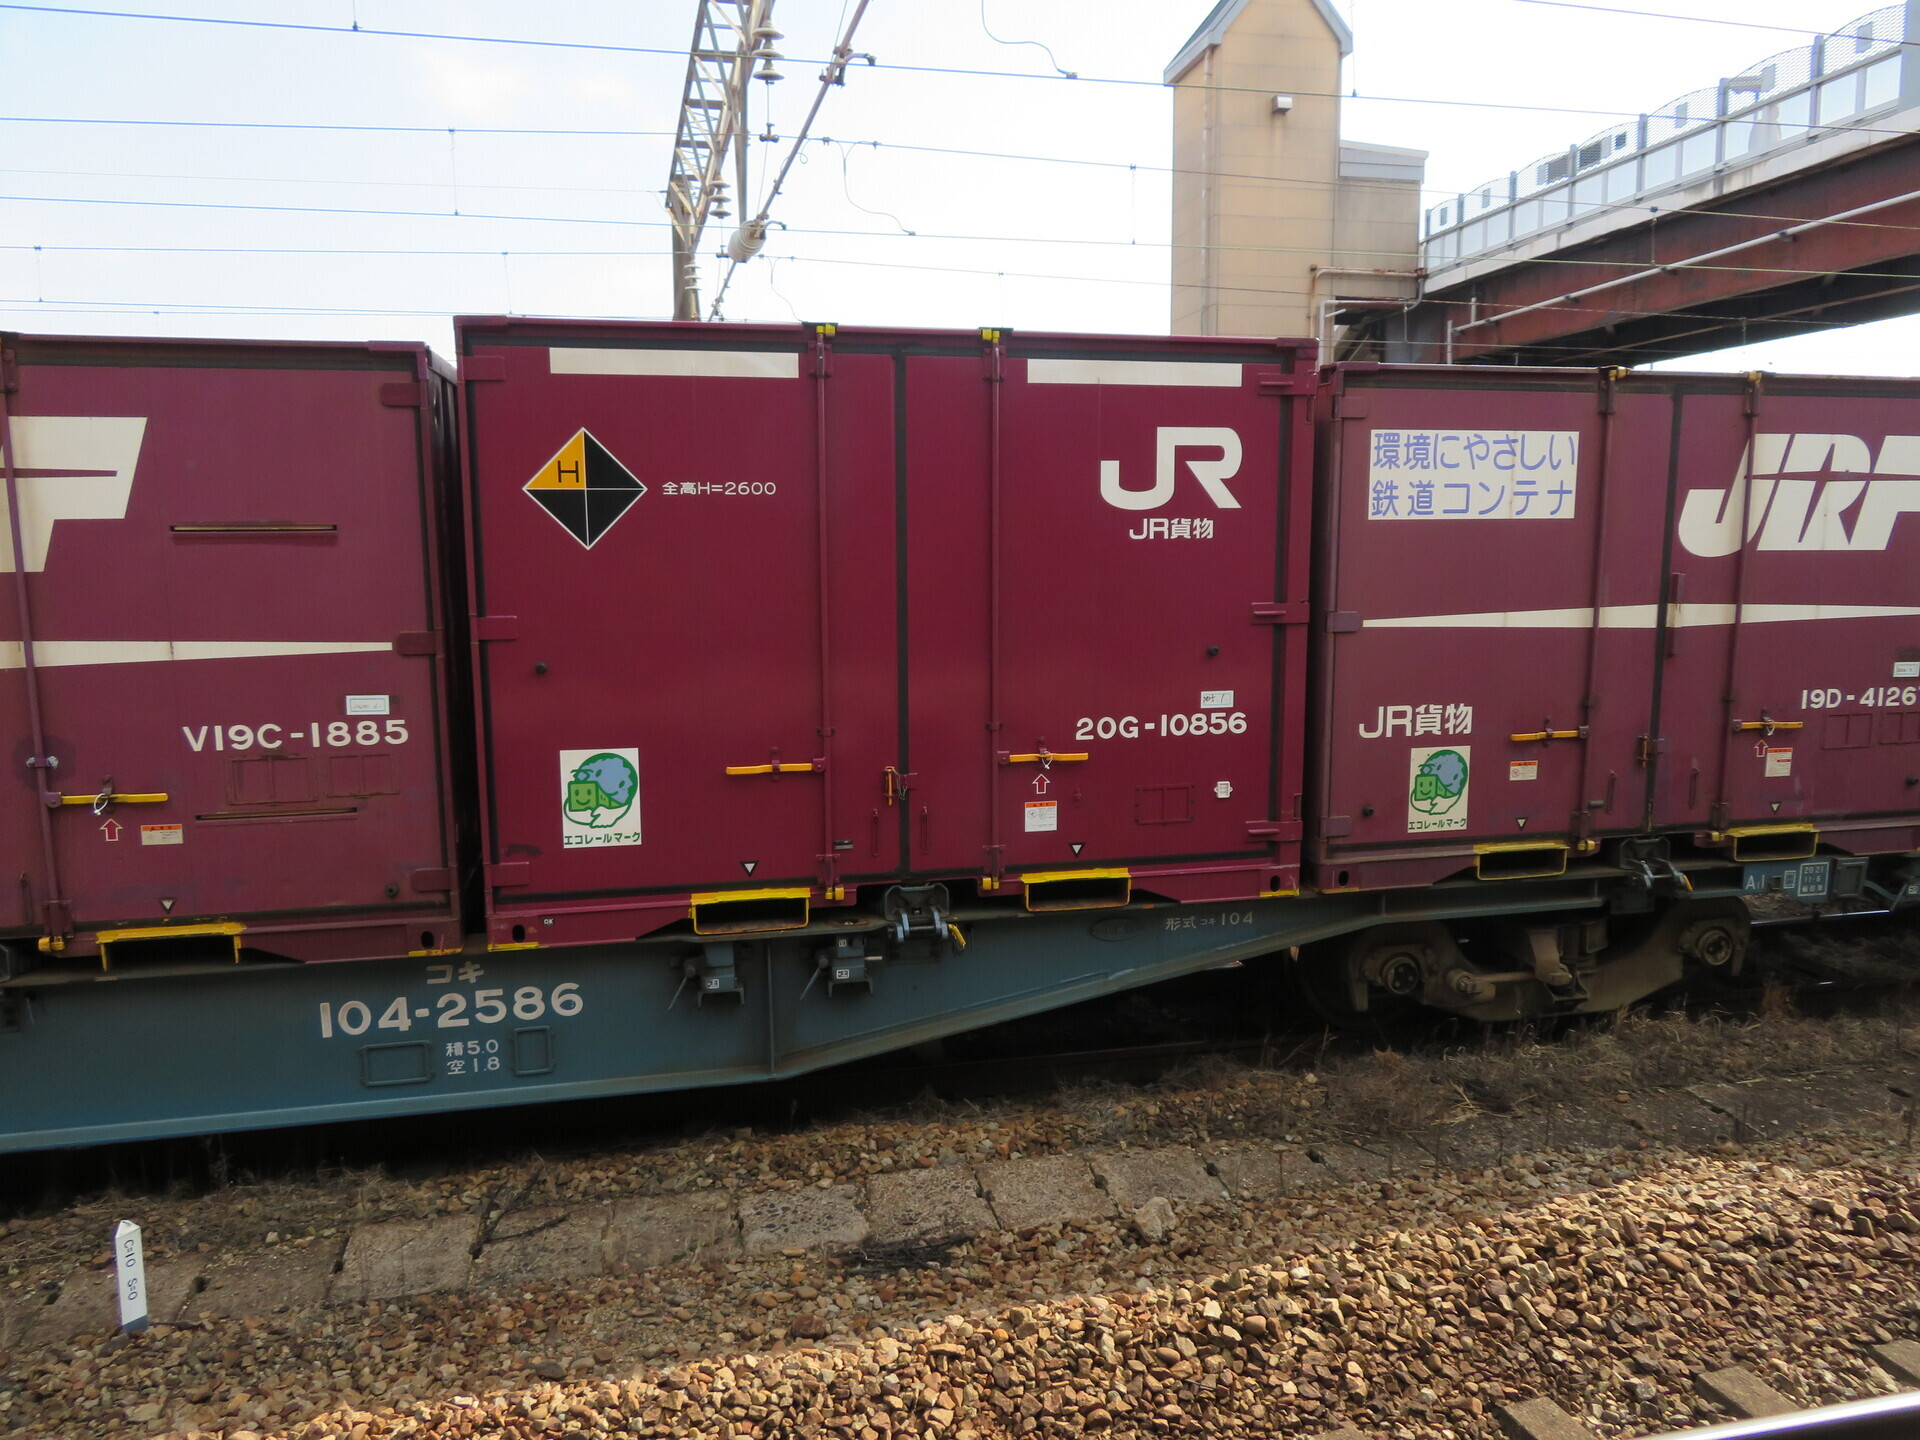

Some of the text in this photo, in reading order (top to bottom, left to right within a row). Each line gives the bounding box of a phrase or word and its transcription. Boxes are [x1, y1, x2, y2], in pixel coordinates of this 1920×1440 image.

[1372, 432, 1576, 471] 環境にやさしい
[557, 460, 580, 483] H
[1100, 426, 1243, 511] JR
[661, 480, 777, 496] 全高H=2600
[1371, 479, 1575, 518] 鉄道コンテナ
[1129, 517, 1214, 540] JR貨物
[1801, 686, 1920, 710] 19D-4126
[1075, 711, 1248, 741] 20G-10856
[1358, 703, 1473, 739] JR貨物
[183, 719, 410, 752] V19C-1885
[1408, 817, 1467, 831] エコレールマーク
[564, 831, 641, 846] エコレールマーク
[425, 961, 485, 985] コキ
[319, 982, 585, 1039] 104-2586
